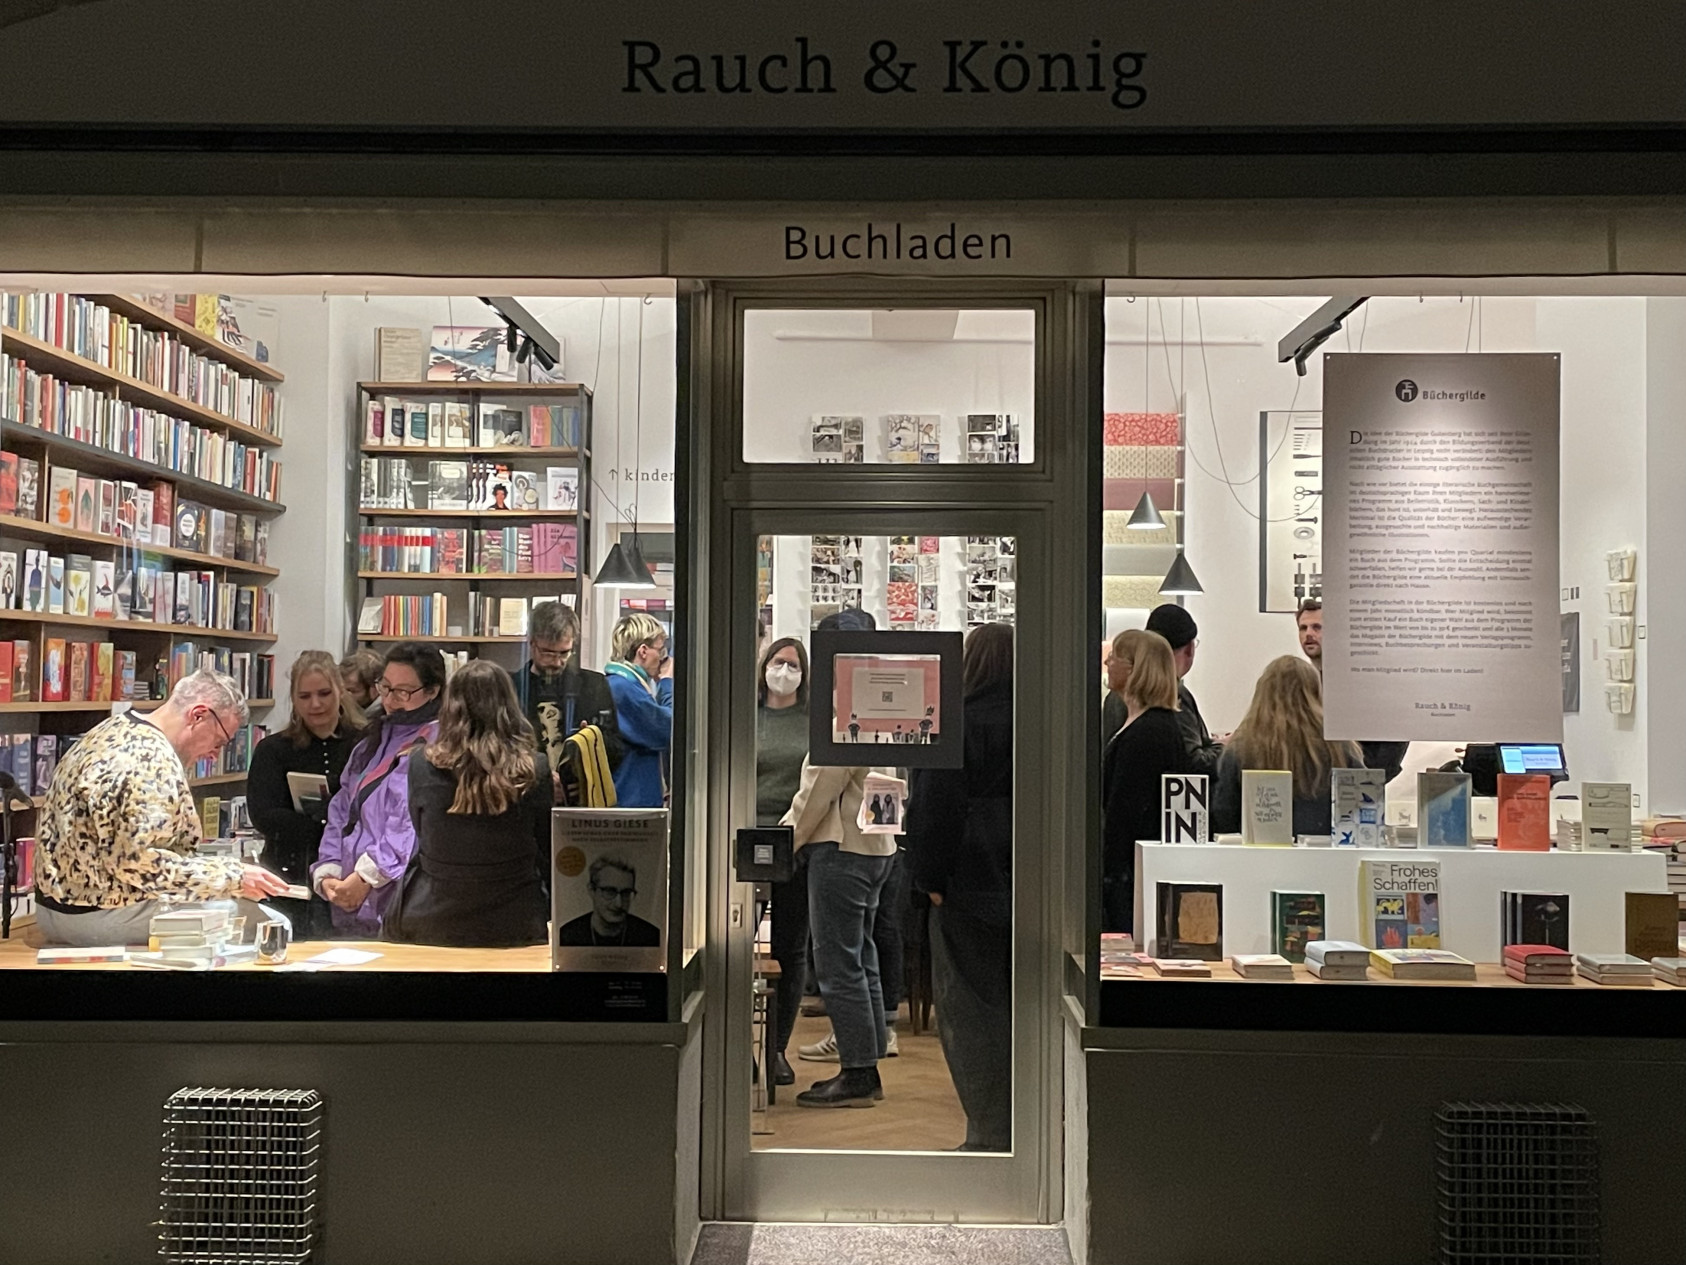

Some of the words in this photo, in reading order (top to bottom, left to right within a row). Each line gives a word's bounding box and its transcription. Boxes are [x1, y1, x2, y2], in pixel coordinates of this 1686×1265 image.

[621, 37, 837, 94] Rauch
[863, 39, 917, 94] &
[942, 38, 1148, 110] König
[784, 222, 1013, 260] Buchladen
[1422, 390, 1486, 402] Büchergilde
[1165, 777, 1206, 810] PN
[571, 819, 609, 828] LINUS
[614, 819, 649, 828] GIESE
[1165, 811, 1197, 843] IN
[1390, 864, 1438, 878] Frohes
[1374, 878, 1438, 891] Schaffen!
